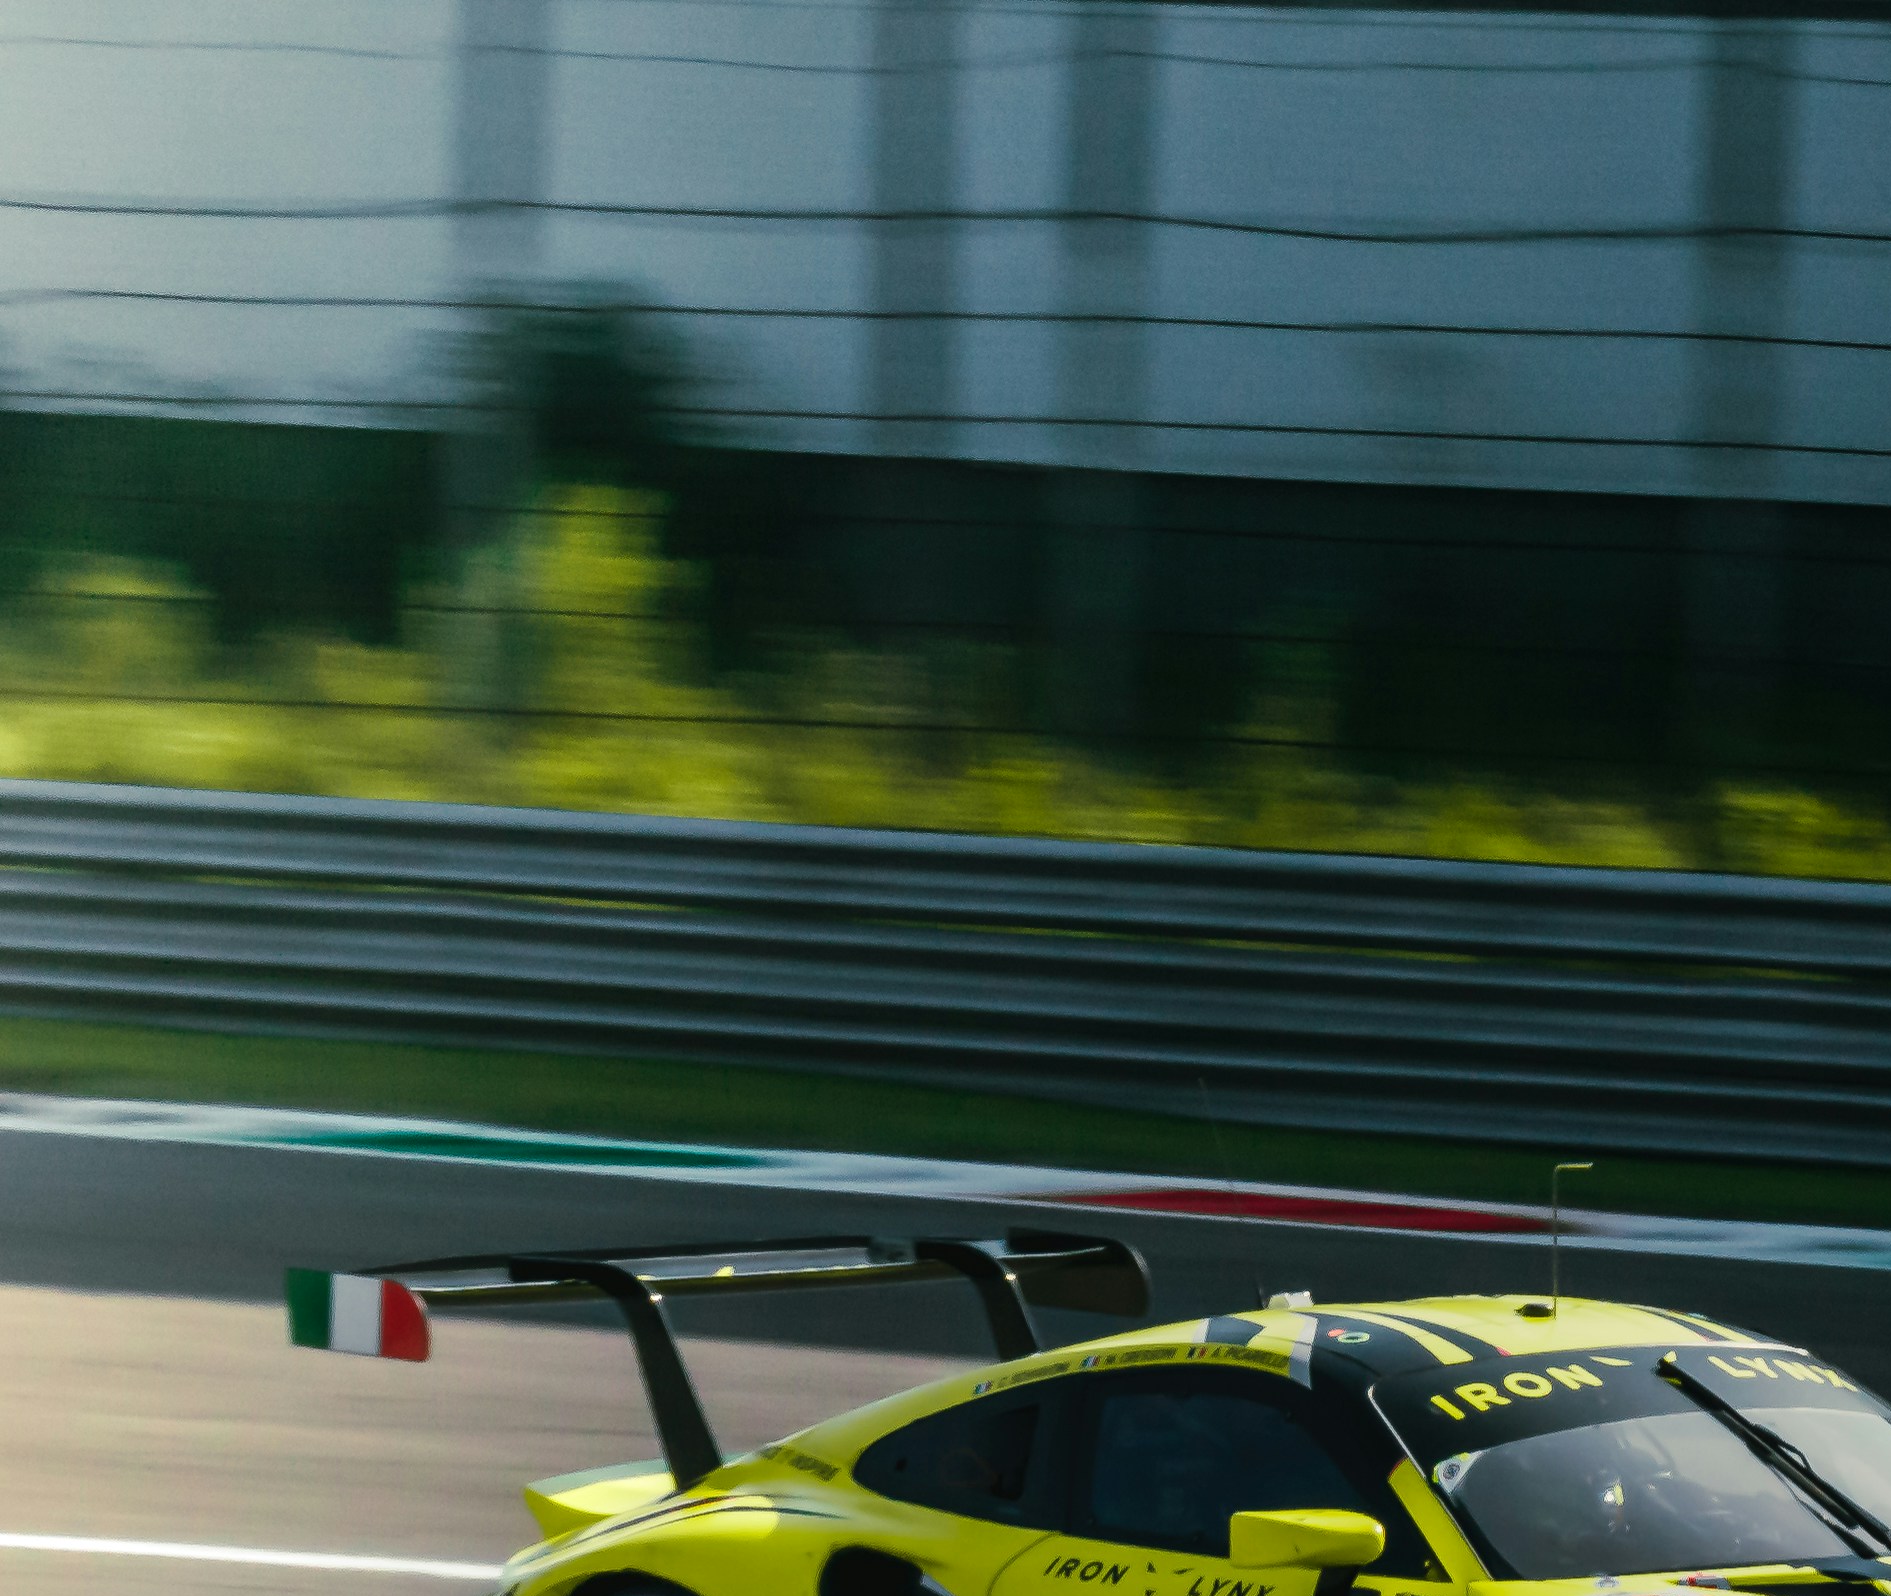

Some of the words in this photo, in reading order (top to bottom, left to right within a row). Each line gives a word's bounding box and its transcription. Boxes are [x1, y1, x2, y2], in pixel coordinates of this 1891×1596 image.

[1430, 1363, 1604, 1421] IRON
[1707, 1354, 1859, 1393] LYNX
[1043, 1555, 1131, 1586] IRON
